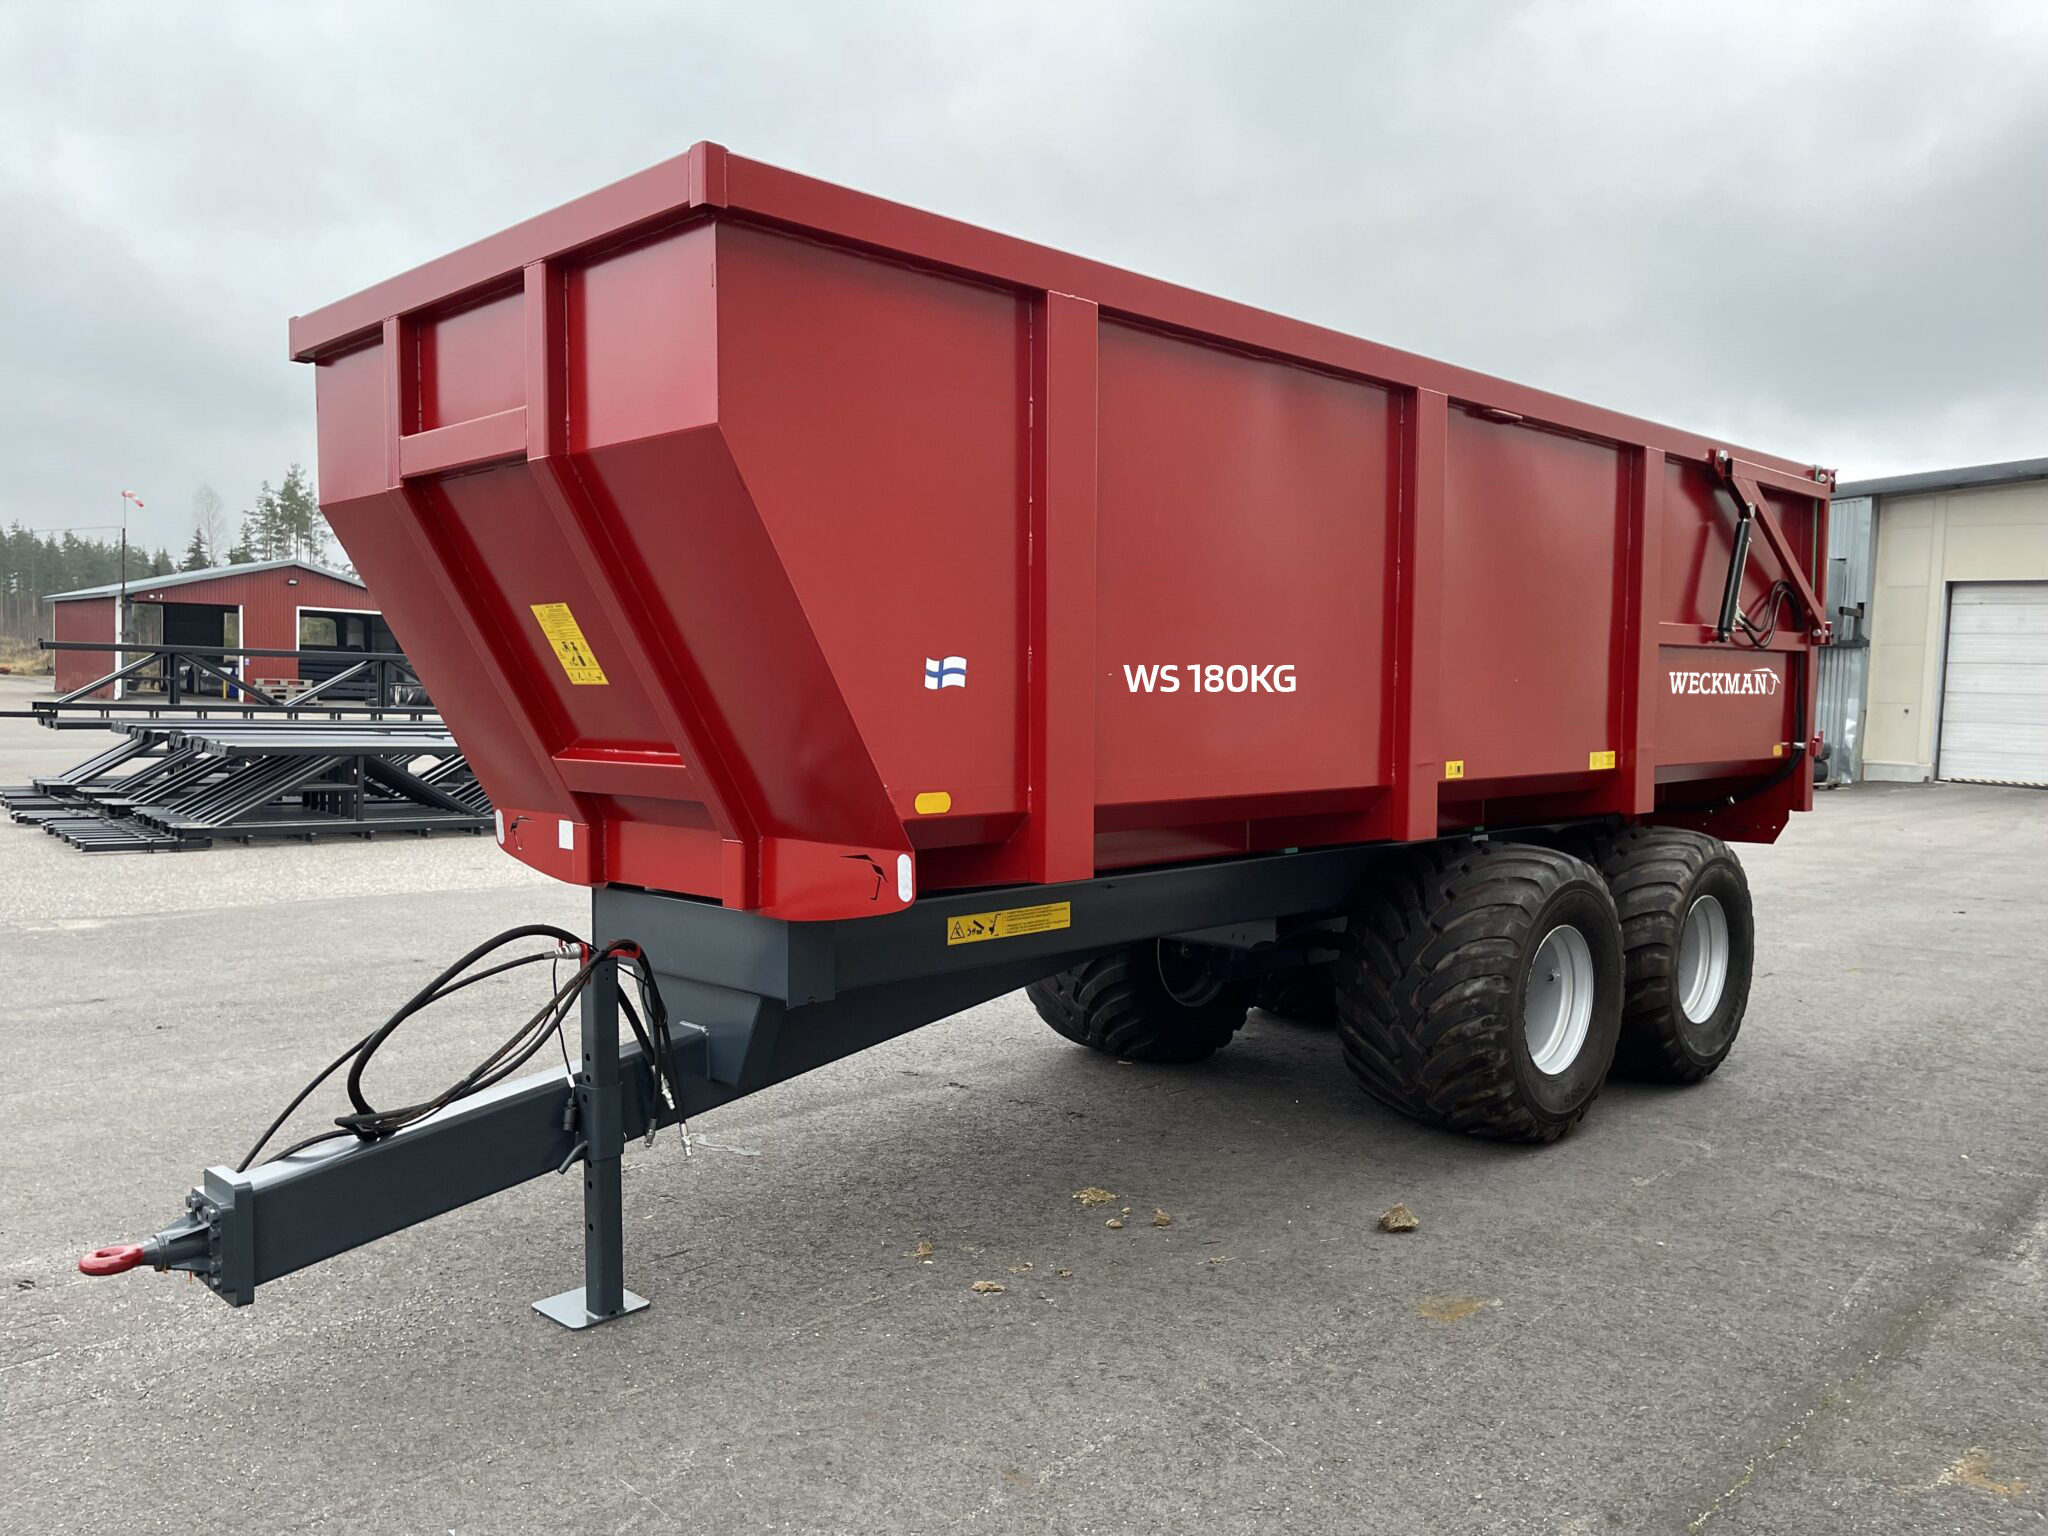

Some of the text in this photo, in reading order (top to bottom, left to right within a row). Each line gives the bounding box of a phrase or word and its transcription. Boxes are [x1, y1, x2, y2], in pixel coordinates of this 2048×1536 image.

[1123, 664, 1297, 693] WS 180KG
[1668, 671, 1767, 695] WECKMAN
